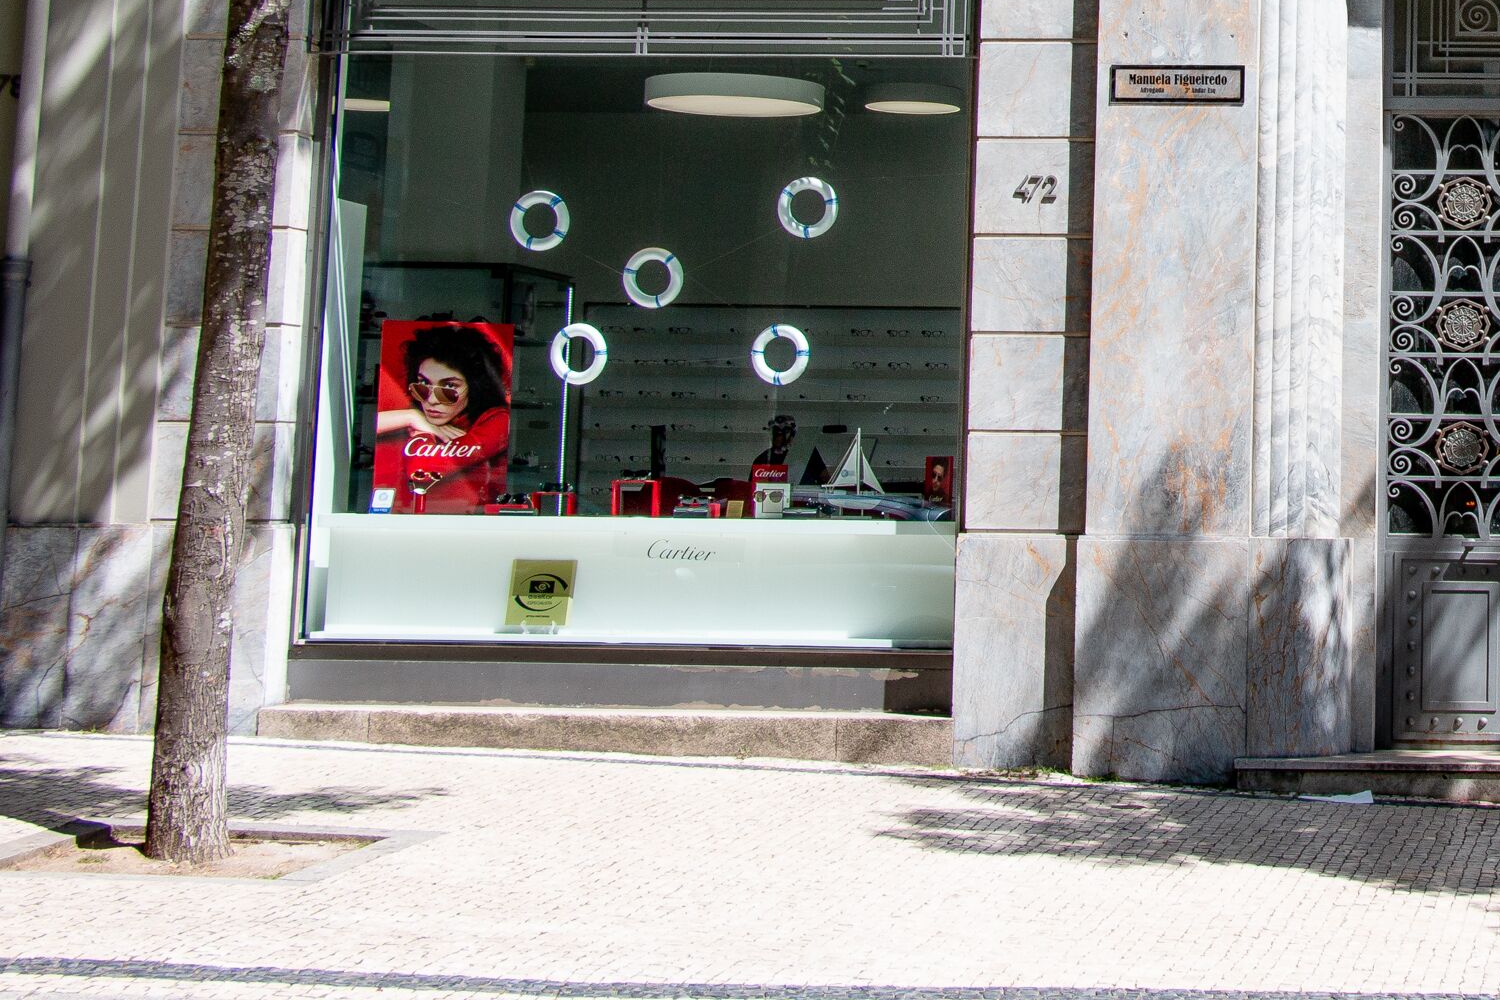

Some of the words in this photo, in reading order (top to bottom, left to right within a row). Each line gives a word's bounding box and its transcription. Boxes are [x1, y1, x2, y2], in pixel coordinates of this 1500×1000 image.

[1128, 73, 1171, 85] Manuela
[1174, 73, 1228, 87] Figueiredo
[1012, 174, 1058, 204] 472
[404, 437, 481, 458] Cartier
[754, 467, 787, 479] Cartier
[646, 539, 717, 562] Cartier
